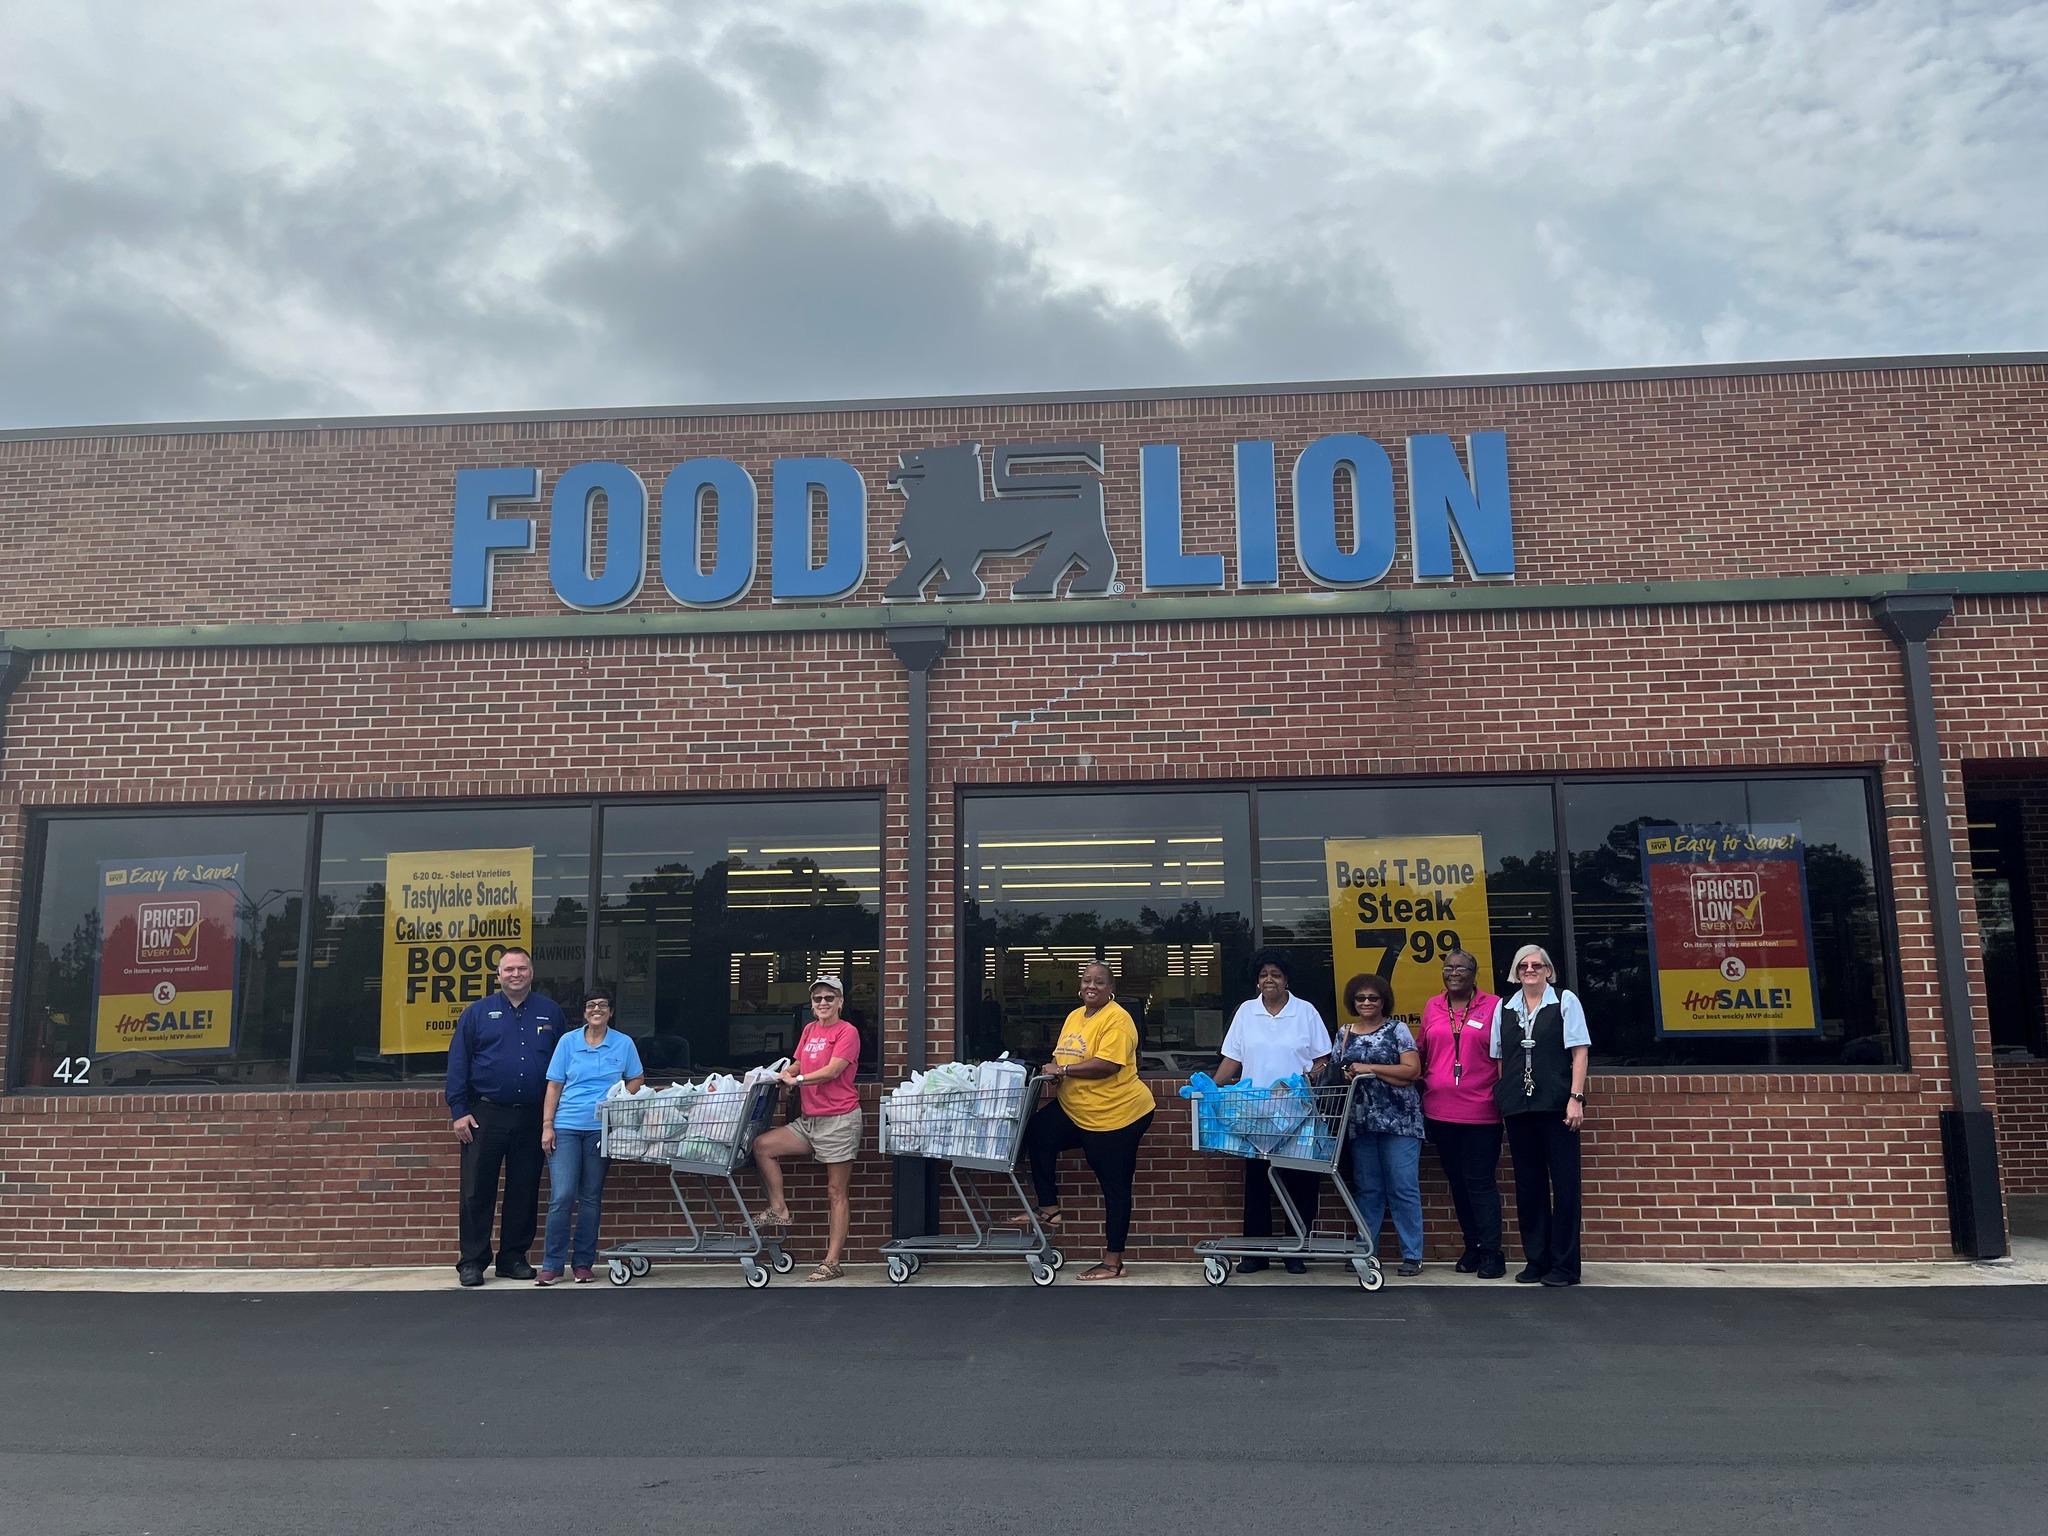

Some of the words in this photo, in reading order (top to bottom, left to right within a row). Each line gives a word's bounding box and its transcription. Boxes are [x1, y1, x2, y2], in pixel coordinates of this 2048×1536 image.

[450, 457, 867, 614] FOOD
[1139, 431, 1515, 592] LION
[1674, 836, 1717, 861] Easy
[1722, 834, 1741, 850] to
[1744, 832, 1796, 851] Save!
[129, 867, 168, 892] Easy
[173, 866, 190, 882] to
[192, 863, 239, 880] Save!
[413, 871, 430, 880] 6-20
[431, 871, 444, 880] Oz.
[450, 870, 474, 879] Select
[476, 869, 511, 878] Varieties
[1336, 860, 1387, 888] Beef
[1393, 858, 1474, 887] T-Bone
[402, 882, 472, 915] Tastykake
[476, 880, 518, 907] Snack
[1697, 879, 1754, 900] PRICED
[1358, 890, 1456, 924] Steak
[1700, 901, 1733, 921] LOW
[143, 908, 194, 928] PRICED
[395, 915, 443, 940] Cakes
[448, 920, 464, 938] or
[468, 913, 521, 937] Donuts
[1700, 921, 1732, 931] EVERY
[1736, 921, 1756, 930] DAY
[142, 929, 174, 949] LOW
[1728, 941, 1739, 949] buy
[141, 949, 171, 958] EVERY
[173, 947, 192, 956] DAY
[407, 944, 508, 974] BOGO
[532, 945, 611, 961] HAWKINSLE
[151, 967, 162, 975] you
[163, 966, 174, 974] buy
[426, 1021, 451, 1030] FOOD
[53, 1057, 91, 1084] 42
